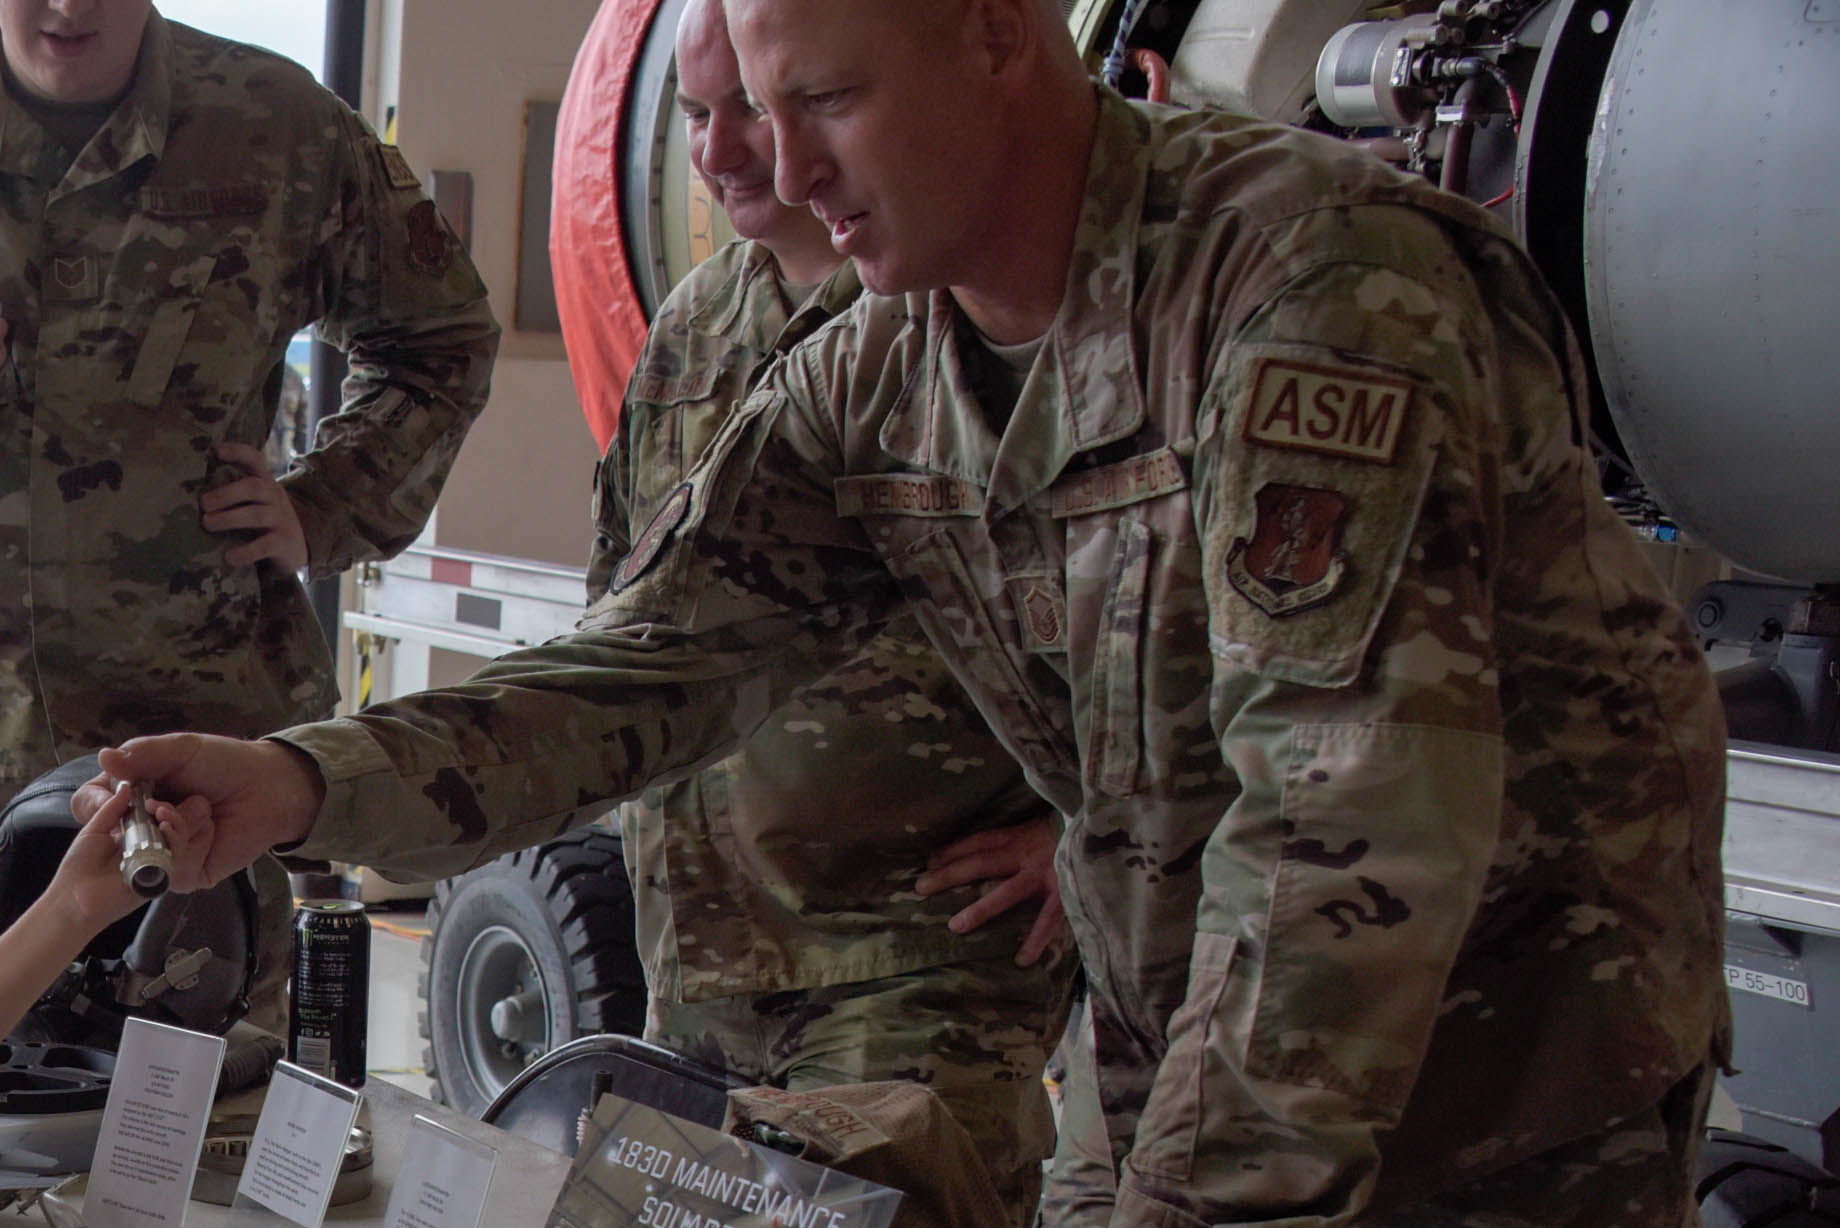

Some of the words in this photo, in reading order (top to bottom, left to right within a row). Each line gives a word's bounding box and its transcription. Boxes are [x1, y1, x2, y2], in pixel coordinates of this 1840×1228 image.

[1261, 377, 1397, 450] ASM
[1745, 972, 1806, 1003] 55-100
[613, 1136, 672, 1179] 183D
